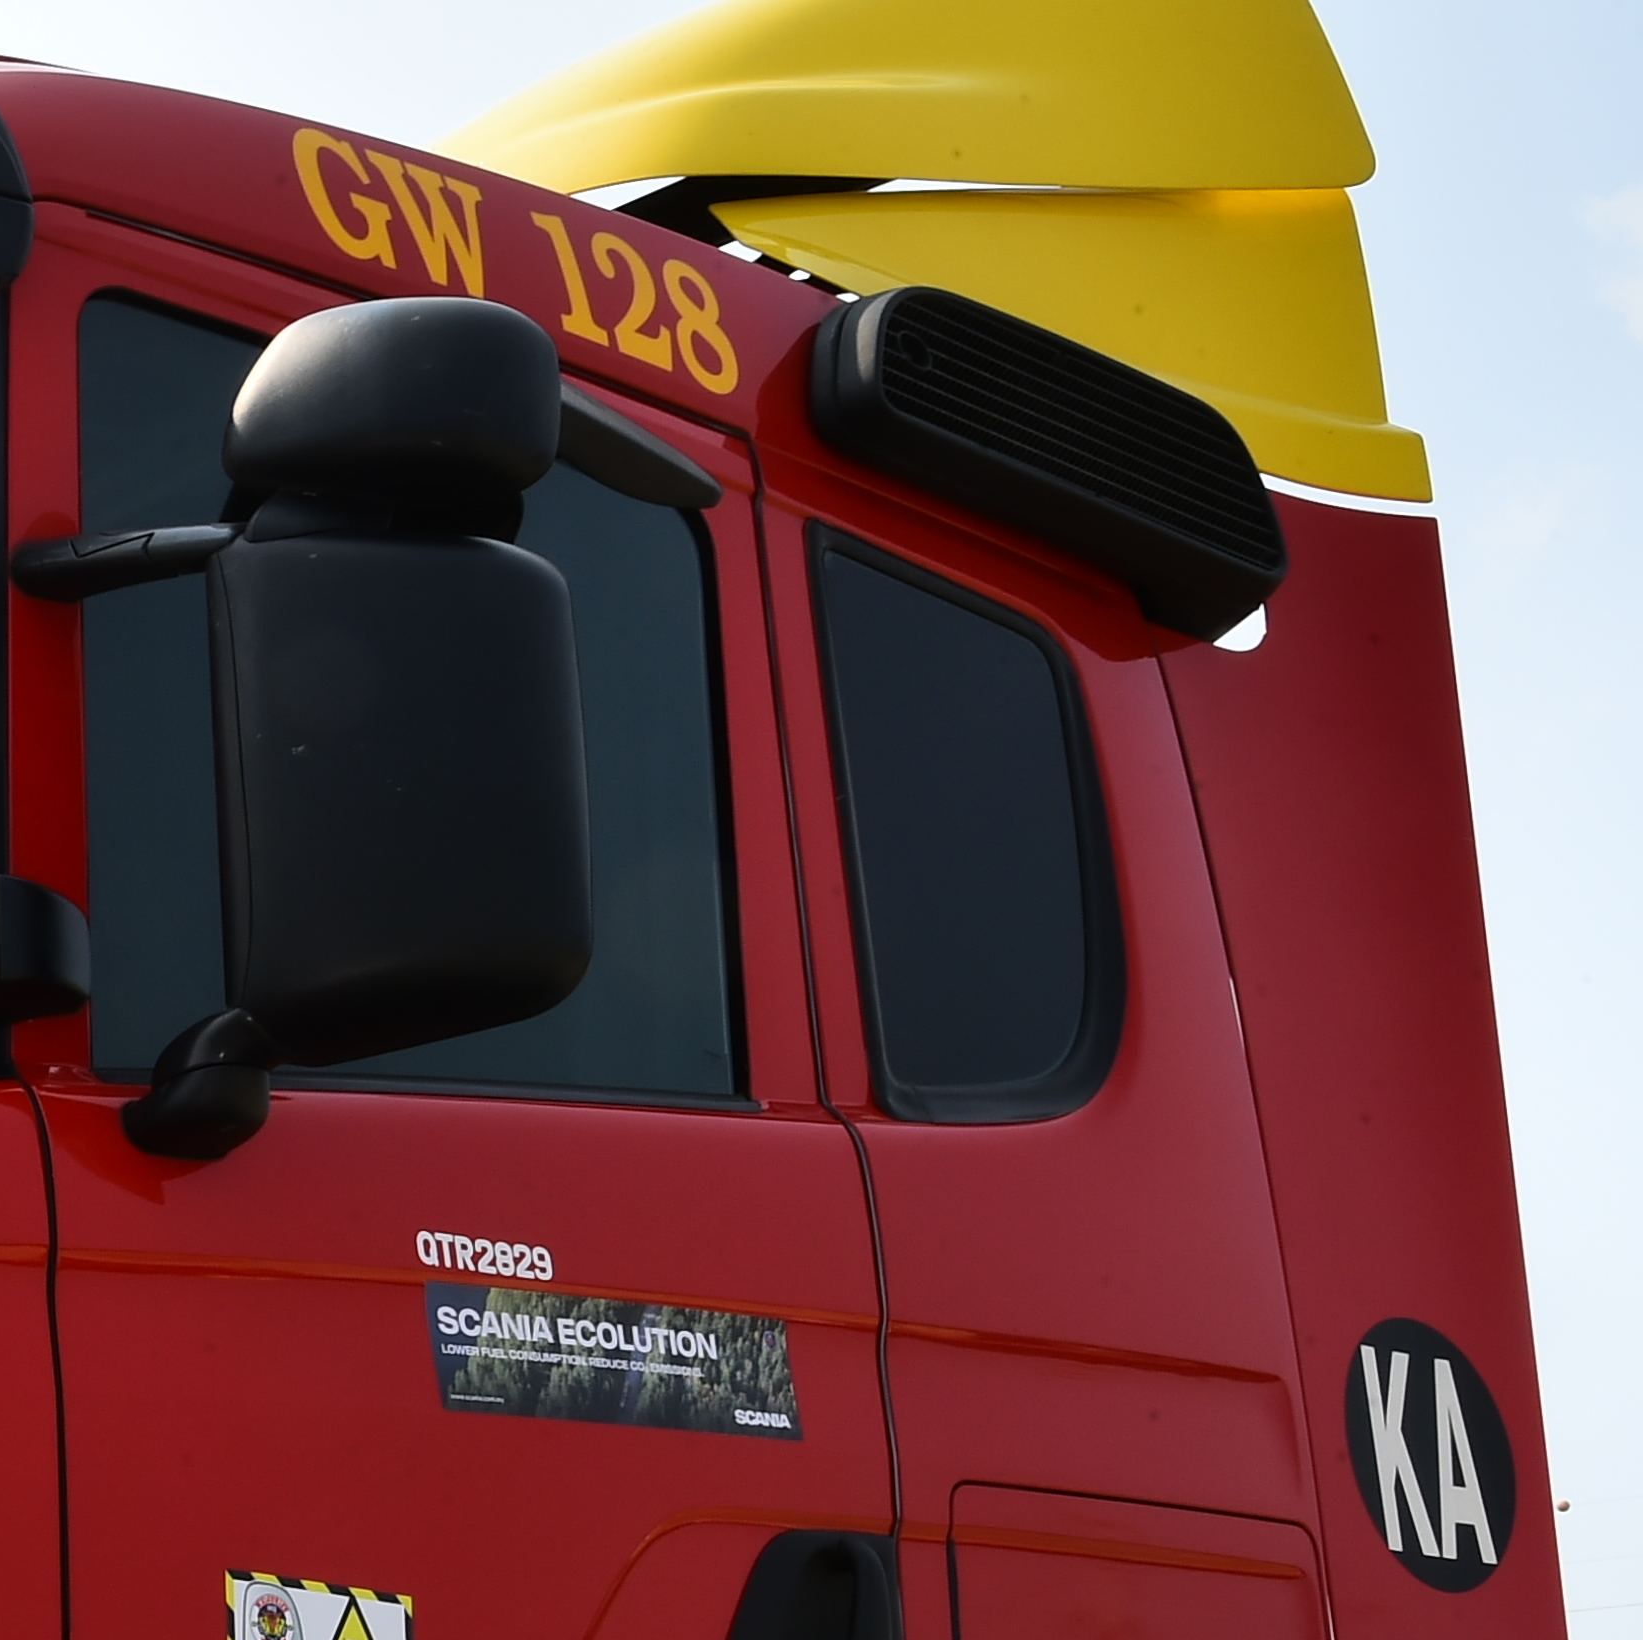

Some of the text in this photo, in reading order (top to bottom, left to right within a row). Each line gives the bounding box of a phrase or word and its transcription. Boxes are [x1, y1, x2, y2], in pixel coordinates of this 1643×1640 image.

[292, 127, 739, 395] GW 128
[416, 1230, 554, 1281] QTR2829
[436, 1305, 719, 1361] SCANIA ECOLUTION
[441, 1343, 480, 1357] LOWER
[589, 1358, 630, 1371] REDUCE
[734, 1408, 792, 1430] SCANIA
[1360, 1344, 1499, 1566] KA
